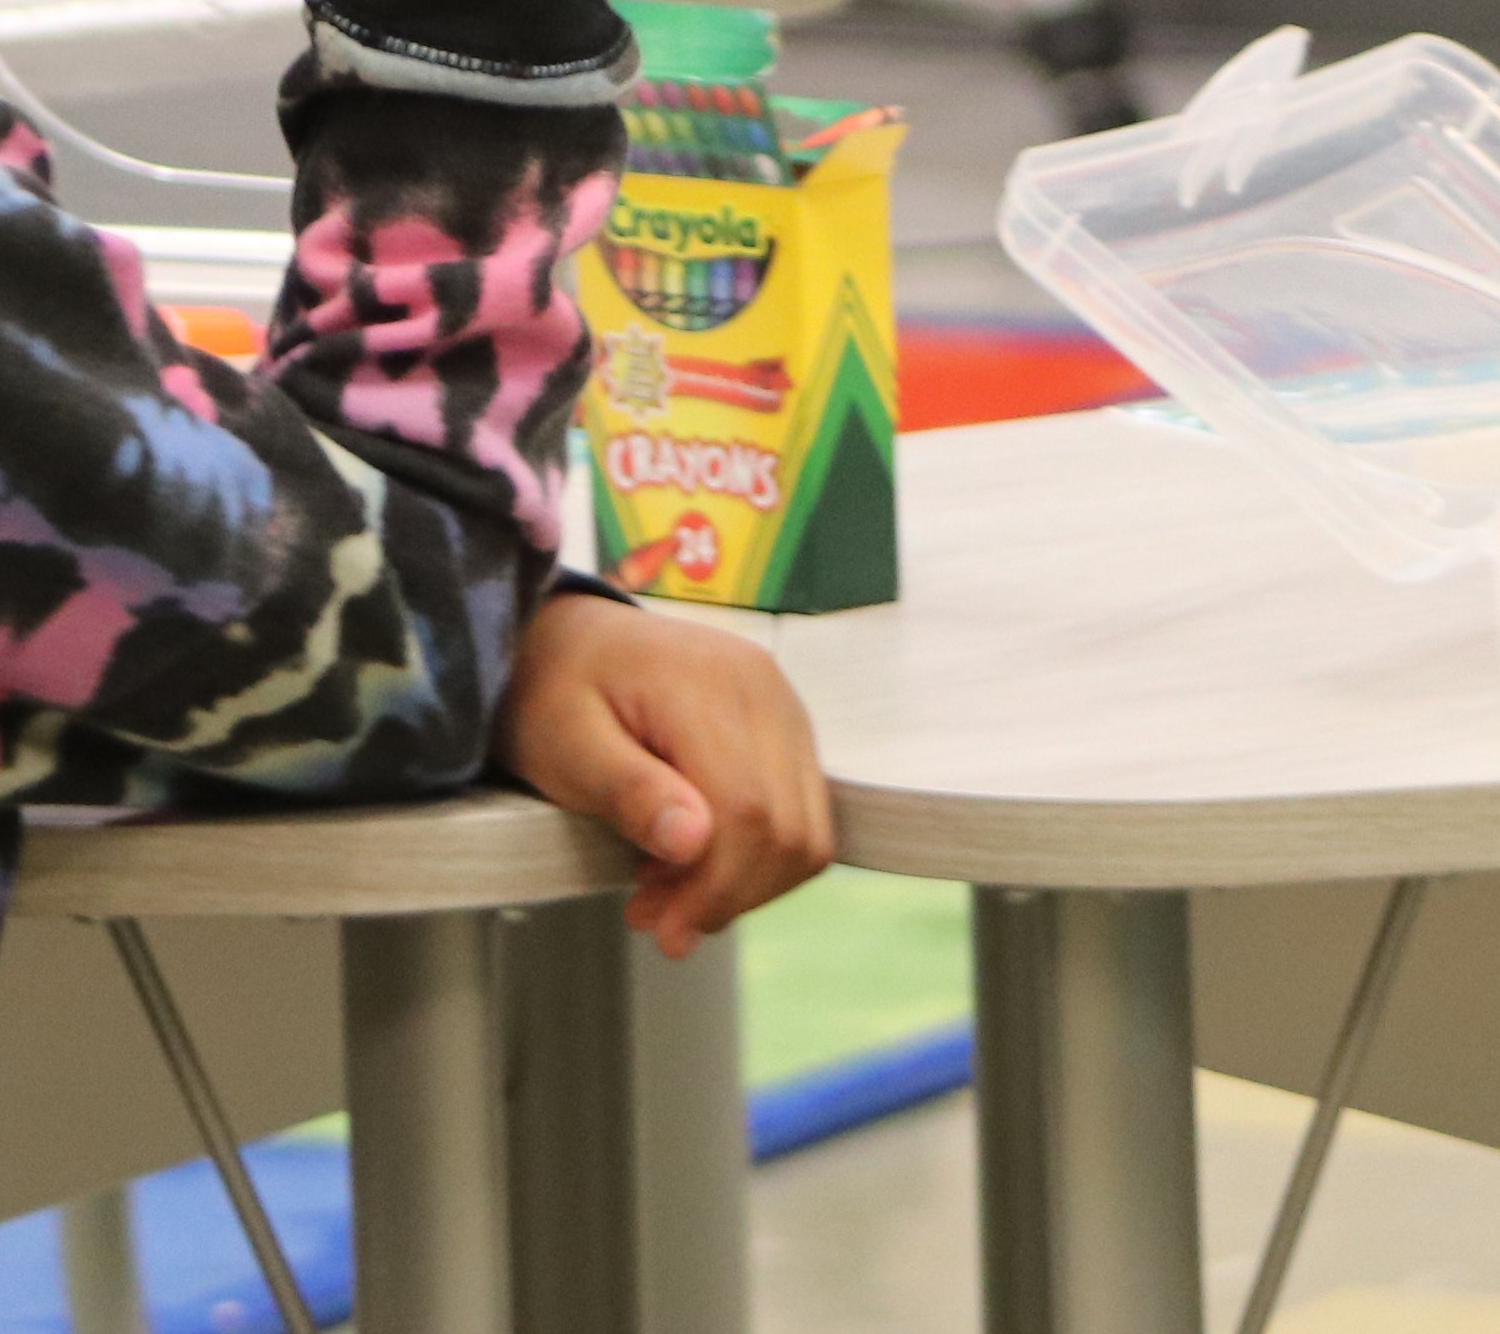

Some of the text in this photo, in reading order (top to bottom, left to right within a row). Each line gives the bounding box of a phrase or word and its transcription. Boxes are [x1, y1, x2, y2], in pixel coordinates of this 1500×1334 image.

[609, 195, 758, 251] Crayola
[606, 433, 781, 508] CRAYONS
[674, 524, 717, 565] 24
